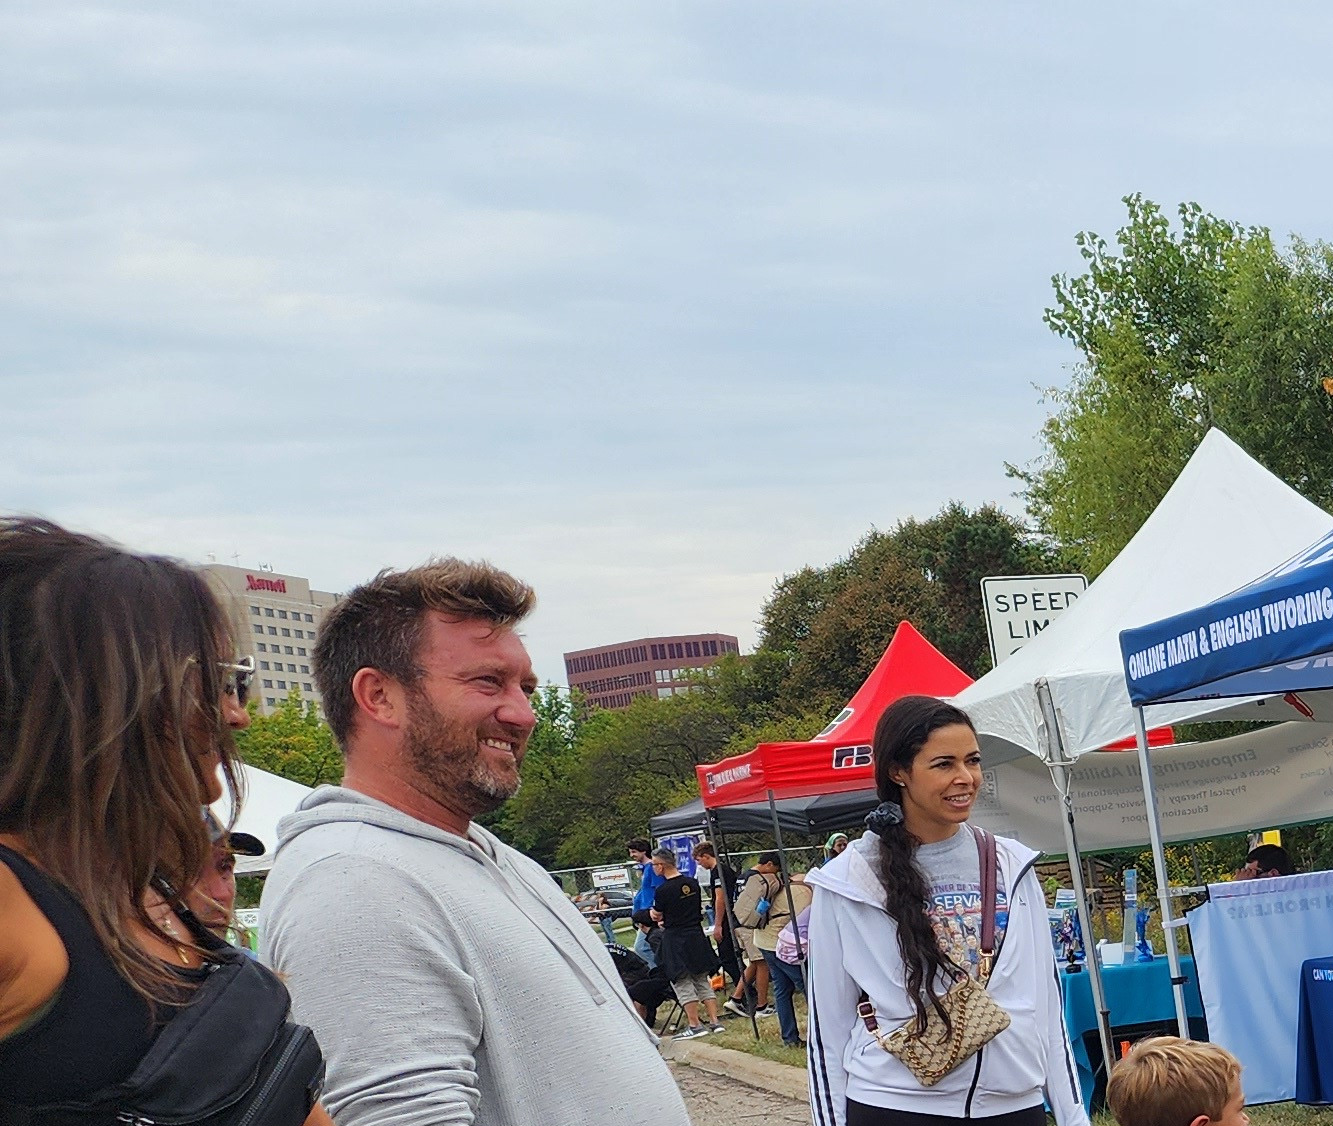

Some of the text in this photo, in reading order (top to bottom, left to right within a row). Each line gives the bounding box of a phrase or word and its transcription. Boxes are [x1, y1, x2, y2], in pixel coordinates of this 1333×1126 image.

[1128, 586, 1333, 681] ONLINE MATH & ENGLISH TUTORING
